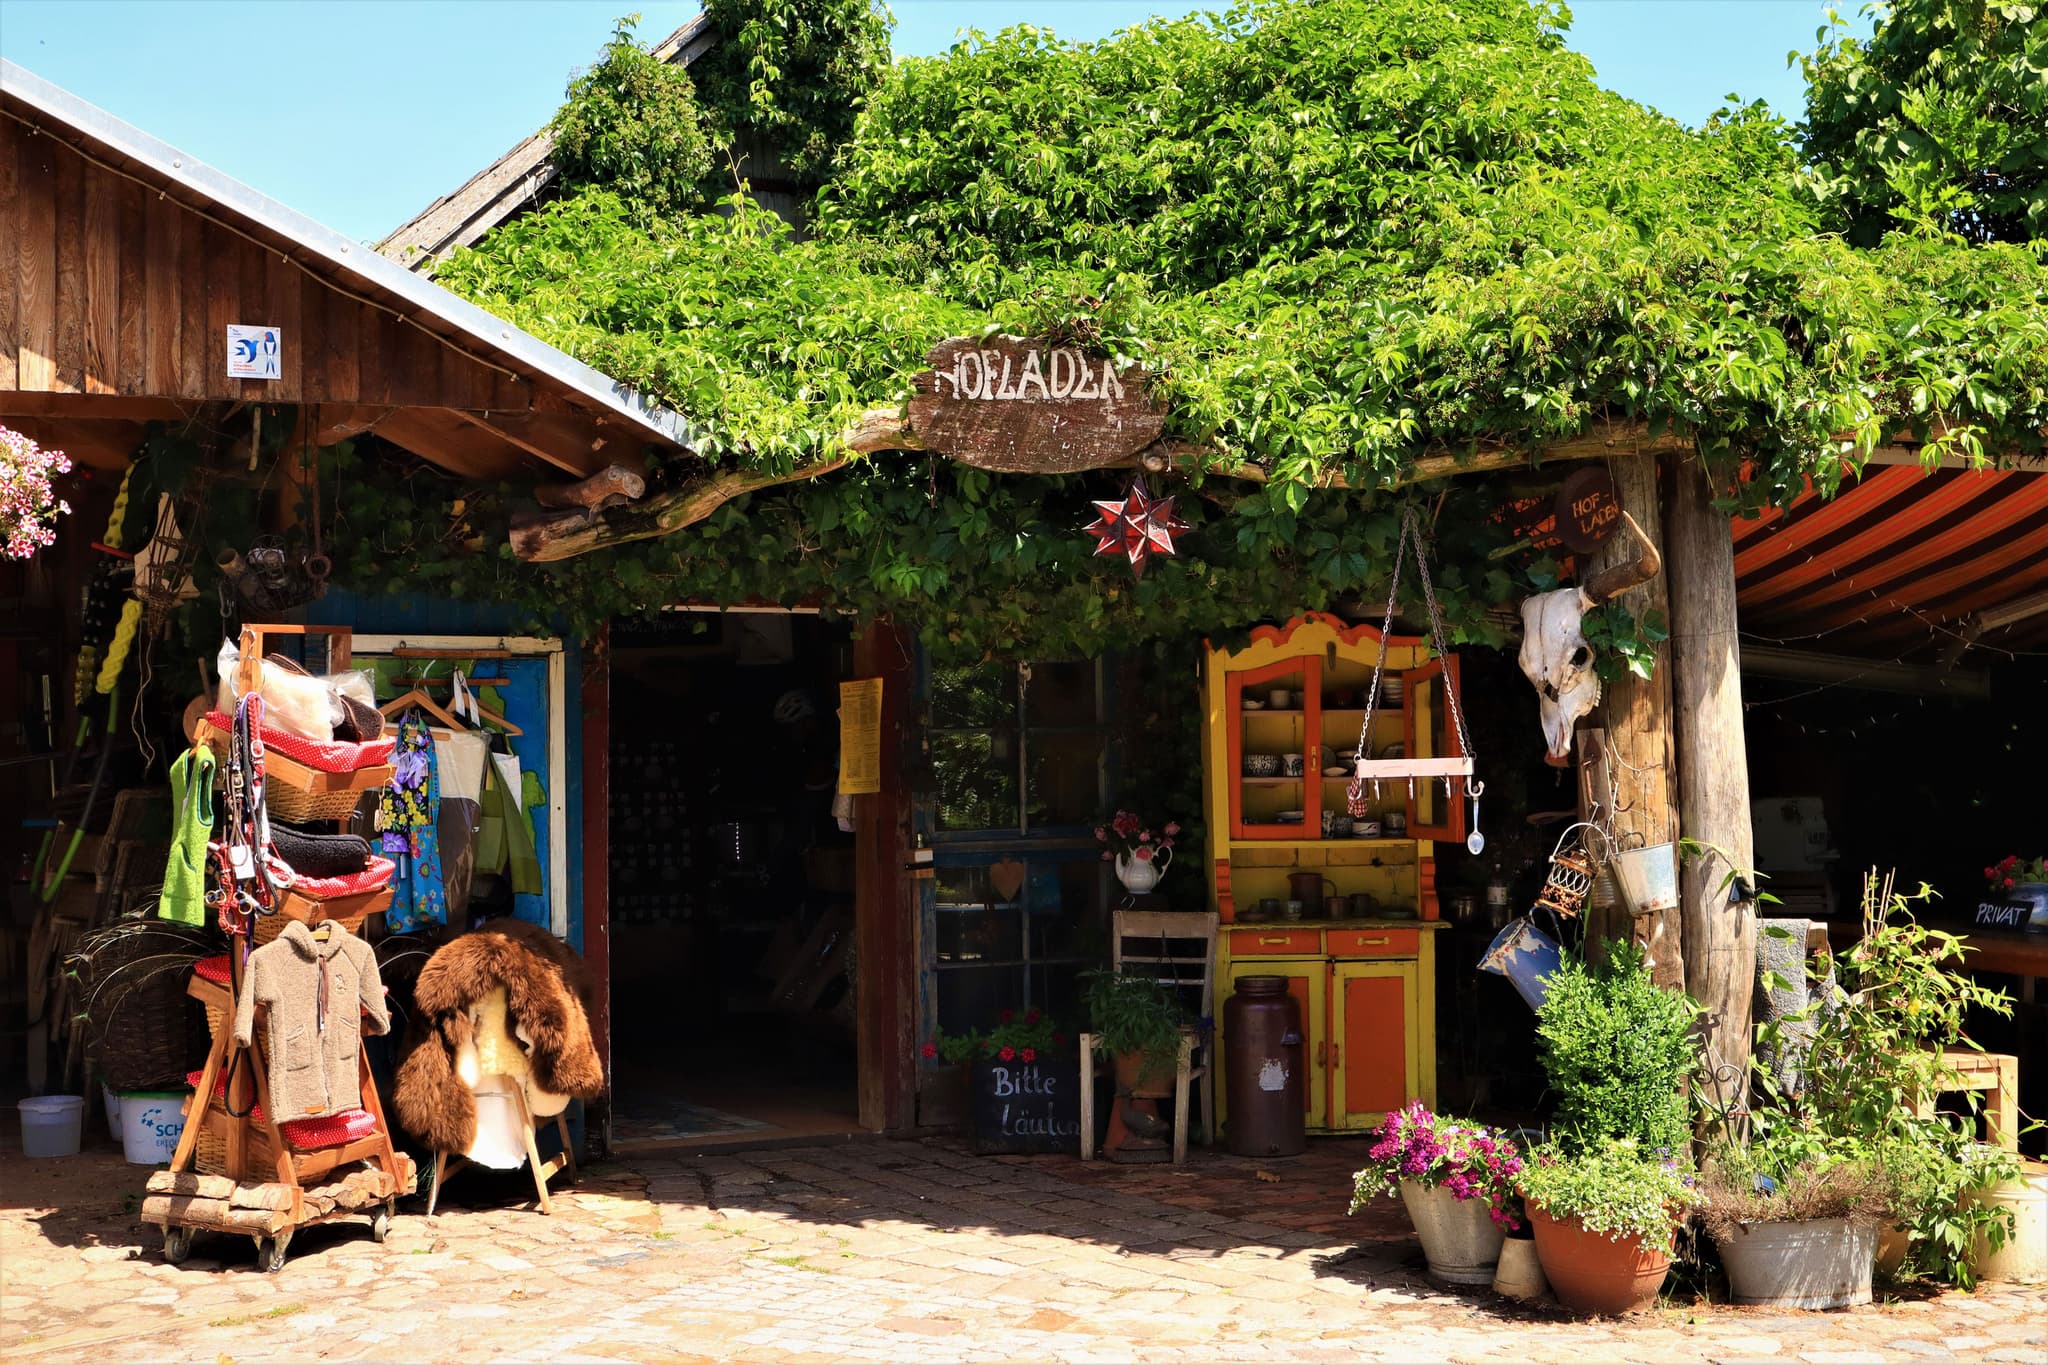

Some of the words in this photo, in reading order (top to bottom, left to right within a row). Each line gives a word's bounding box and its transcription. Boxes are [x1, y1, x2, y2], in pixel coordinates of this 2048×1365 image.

[1580, 503, 1619, 535] LADEN
[1975, 902, 2027, 926] PRIVAT
[992, 1065, 1057, 1097] Bitte
